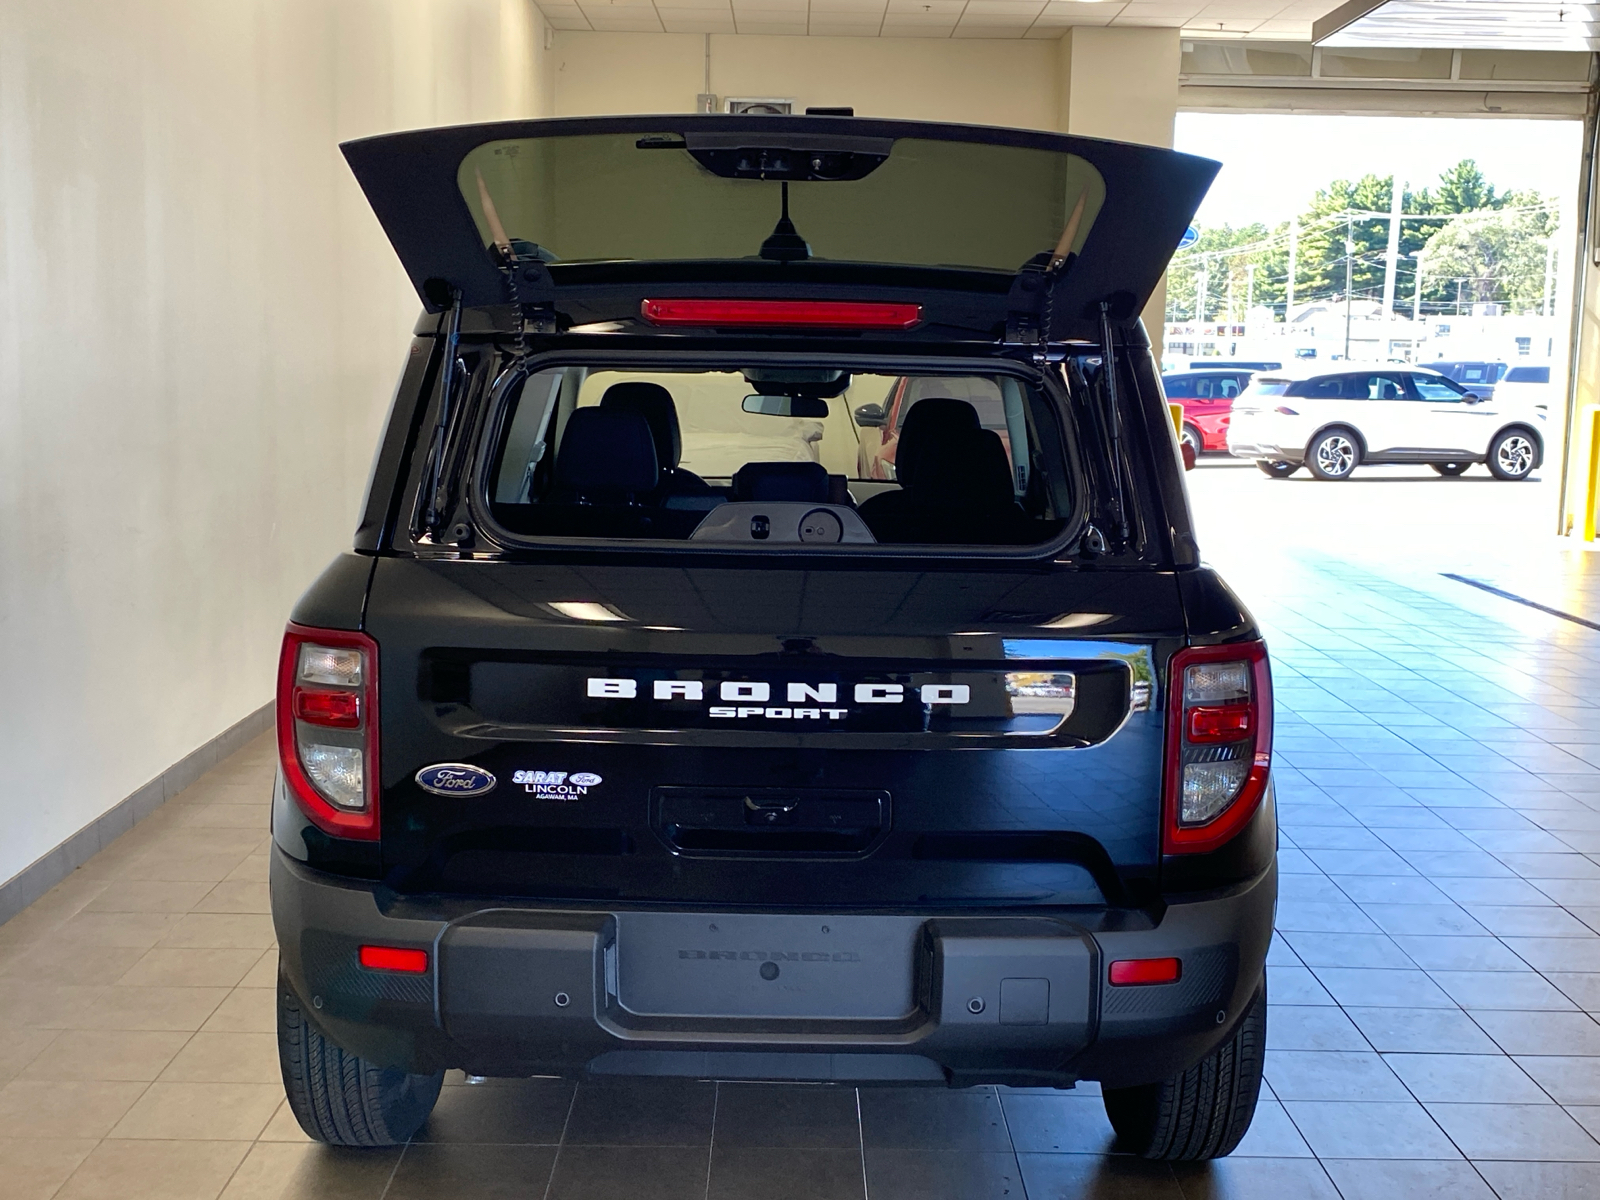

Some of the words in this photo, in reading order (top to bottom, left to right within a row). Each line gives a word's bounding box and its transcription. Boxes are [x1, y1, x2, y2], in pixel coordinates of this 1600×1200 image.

[587, 677, 970, 704] BRONCO
[709, 706, 848, 720] SPORT
[433, 769, 477, 790] Ford
[512, 770, 568, 785] SARAT
[525, 784, 587, 795] LINCOLN
[536, 793, 566, 801] AGAWAM,
[677, 949, 861, 962] BRONCO
